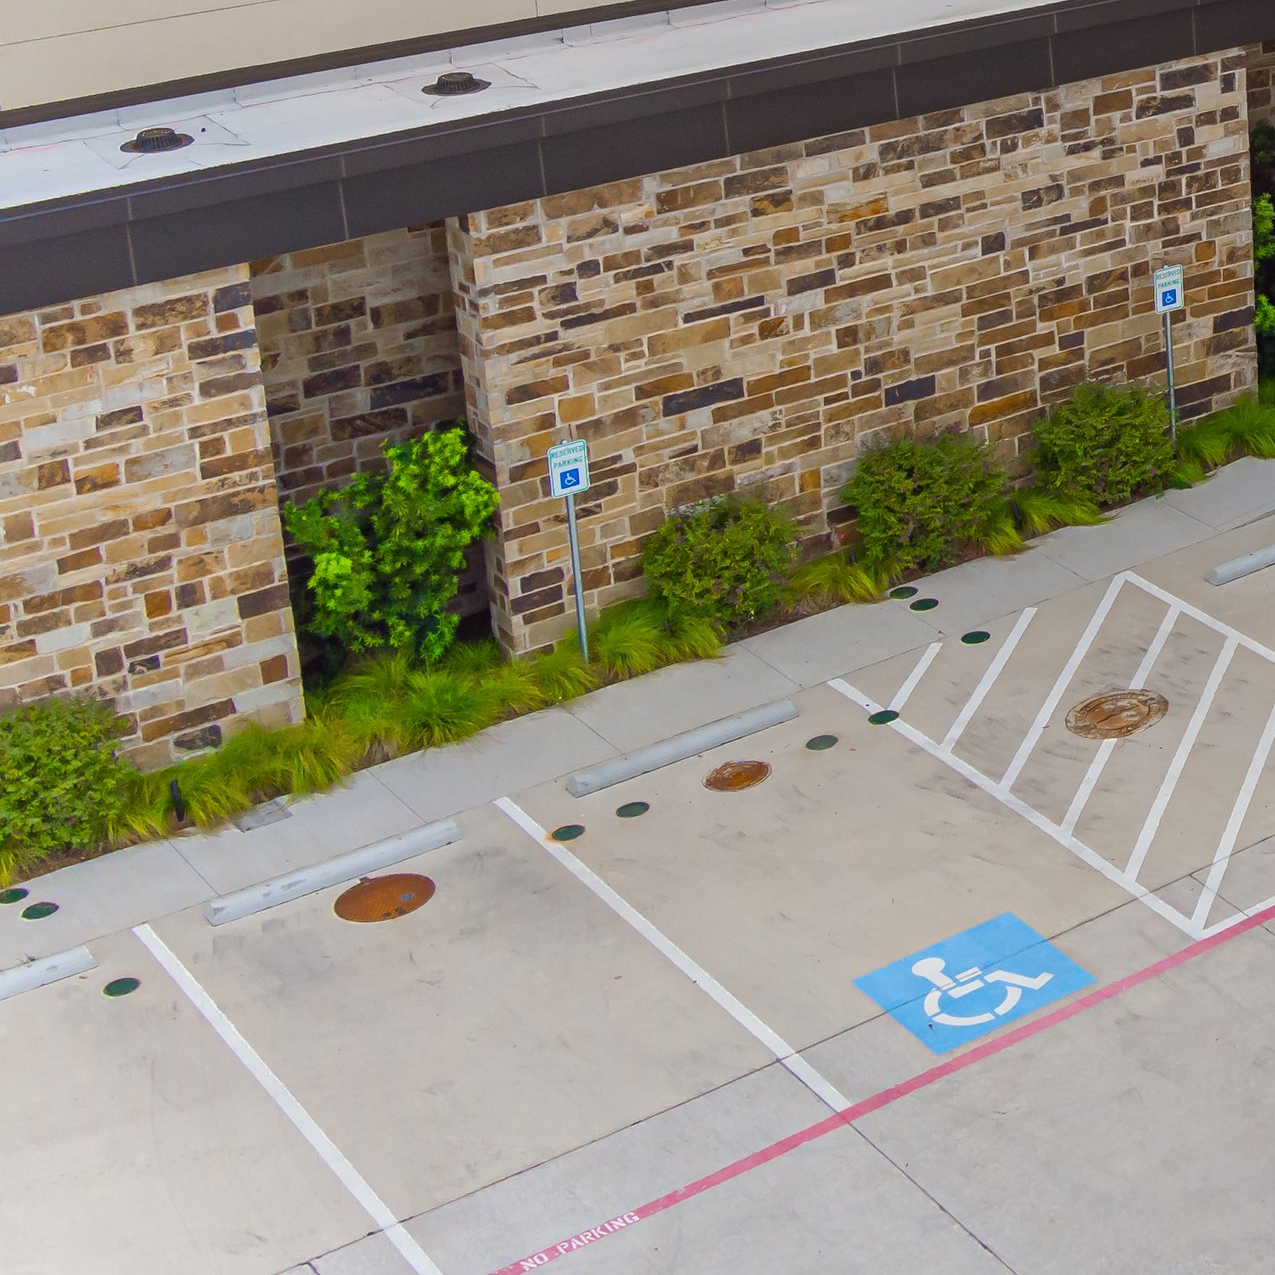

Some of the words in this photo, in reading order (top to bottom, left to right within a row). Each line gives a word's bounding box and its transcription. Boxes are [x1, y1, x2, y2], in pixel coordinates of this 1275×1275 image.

[551, 445, 585, 459] RESERVED
[553, 455, 583, 469] PARKING
[519, 1252, 550, 1272] NO
[556, 1211, 640, 1256] PARKING
